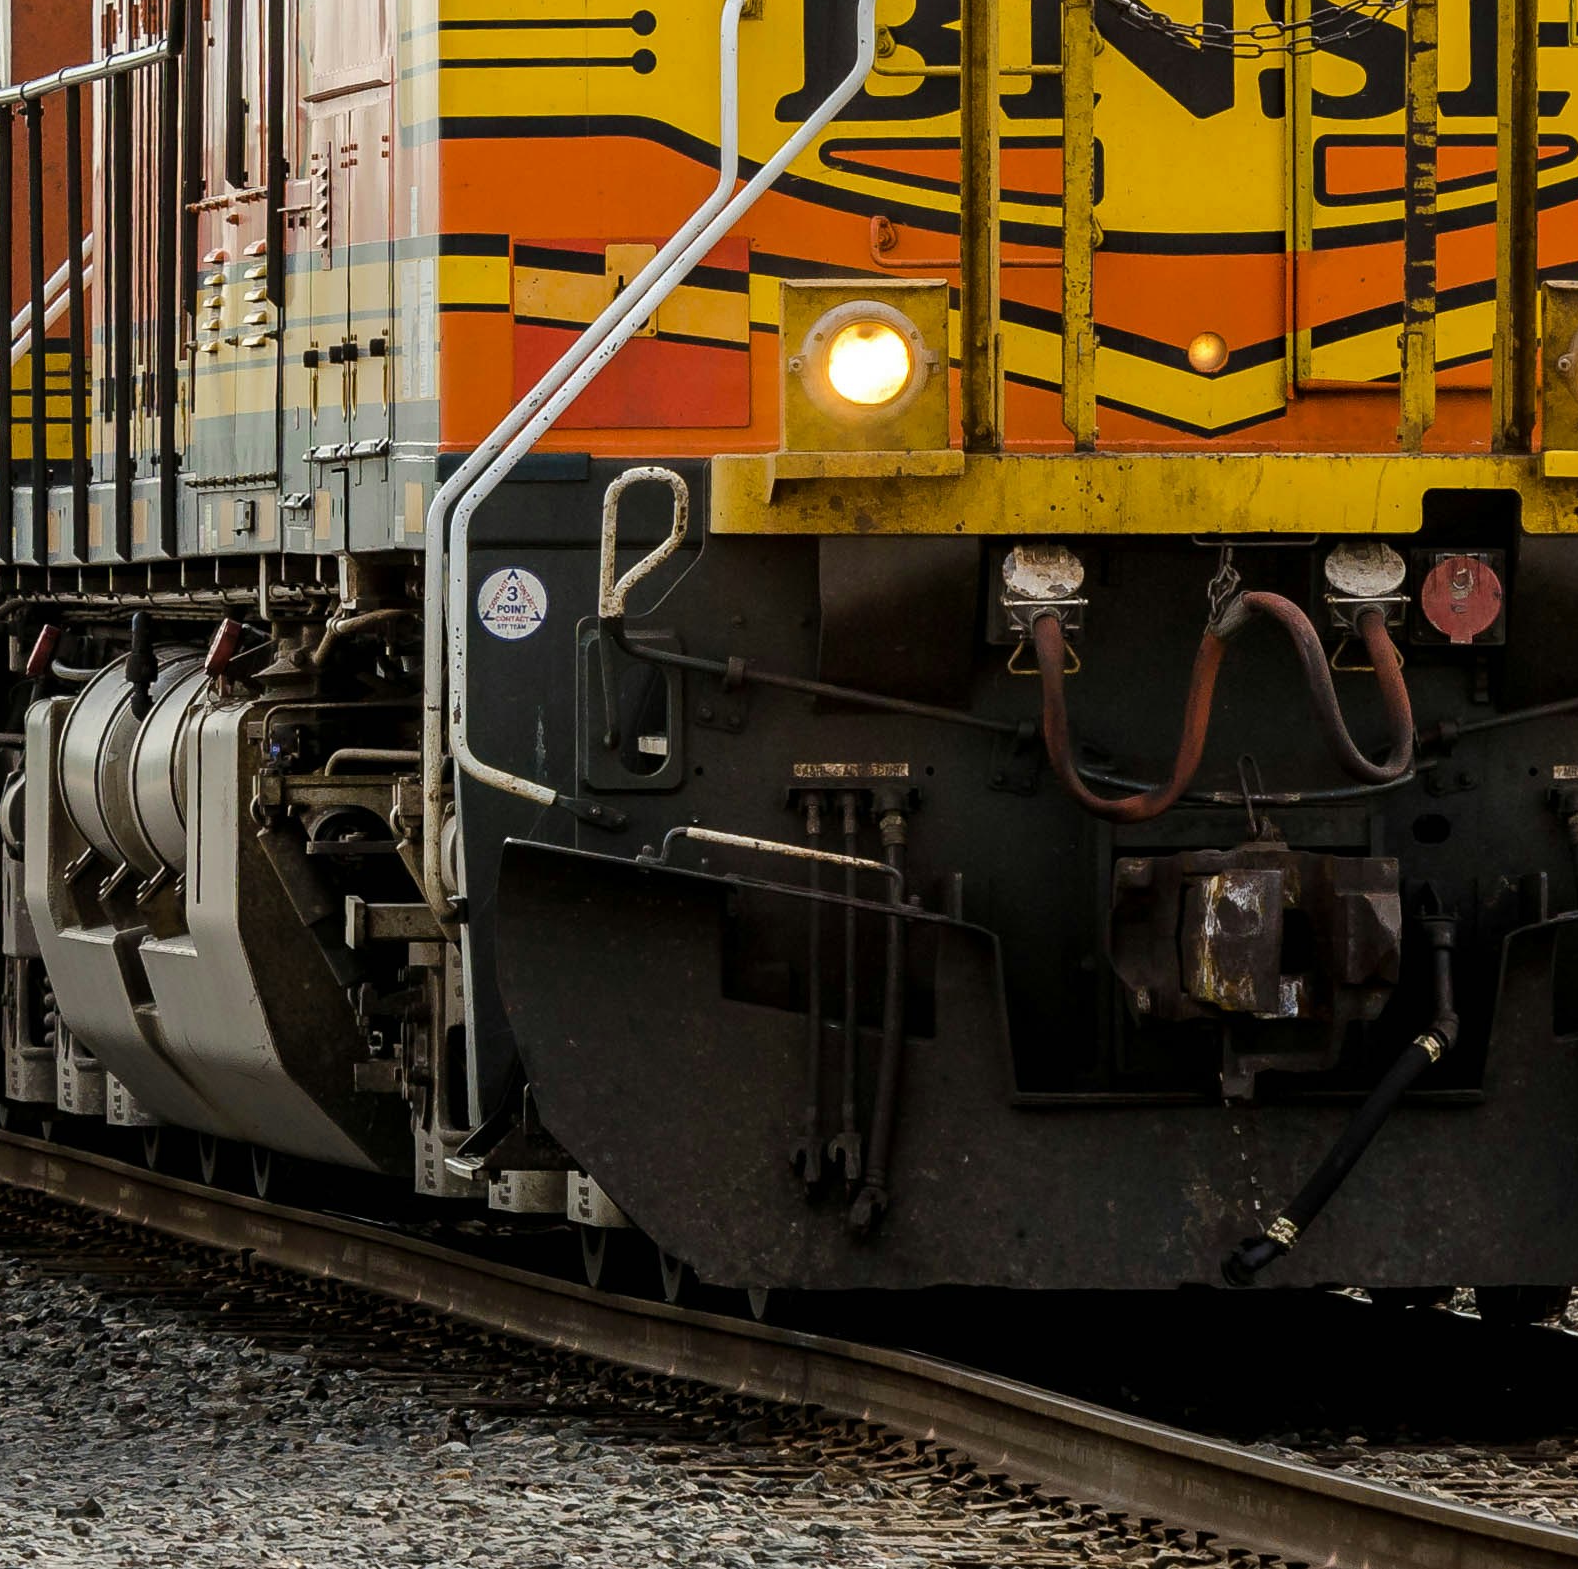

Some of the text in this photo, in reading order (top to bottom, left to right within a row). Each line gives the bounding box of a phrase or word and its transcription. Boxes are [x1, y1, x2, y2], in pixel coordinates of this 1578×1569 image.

[489, 579, 510, 610] CONTACT
[507, 586, 519, 602] 3
[516, 580, 538, 611] CONTACT
[497, 604, 528, 614] POINT
[495, 615, 530, 623] CONTACT
